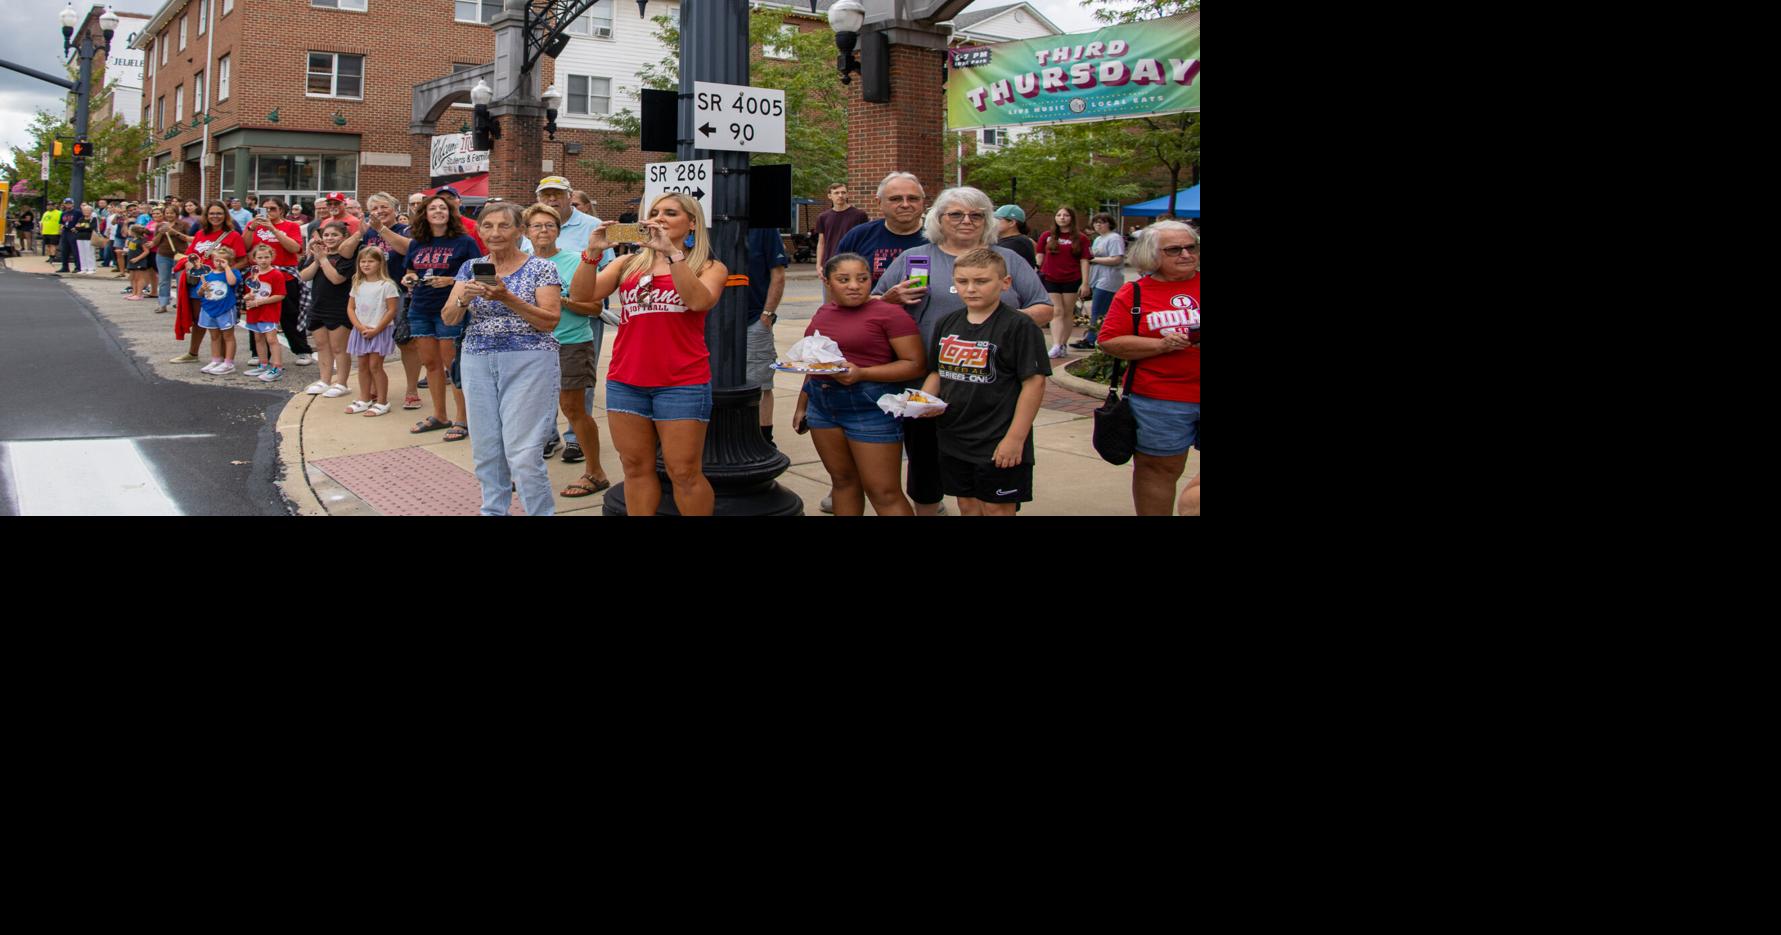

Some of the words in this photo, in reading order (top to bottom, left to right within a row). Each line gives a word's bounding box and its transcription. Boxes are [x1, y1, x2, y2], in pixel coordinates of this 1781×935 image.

[972, 51, 988, 59] PM
[1034, 40, 1130, 66] THIRD
[966, 58, 1200, 112] THURSDAY
[698, 92, 722, 112] SR
[732, 95, 783, 117] 4005
[1034, 105, 1065, 113] MUSIC
[1091, 99, 1127, 108] LOCAL
[1133, 95, 1164, 104] EATS
[730, 123, 754, 142] 90
[650, 166, 667, 182] SR
[677, 163, 706, 181] 286
[413, 252, 453, 264] EAST
[629, 304, 669, 313] SOFTBALL
